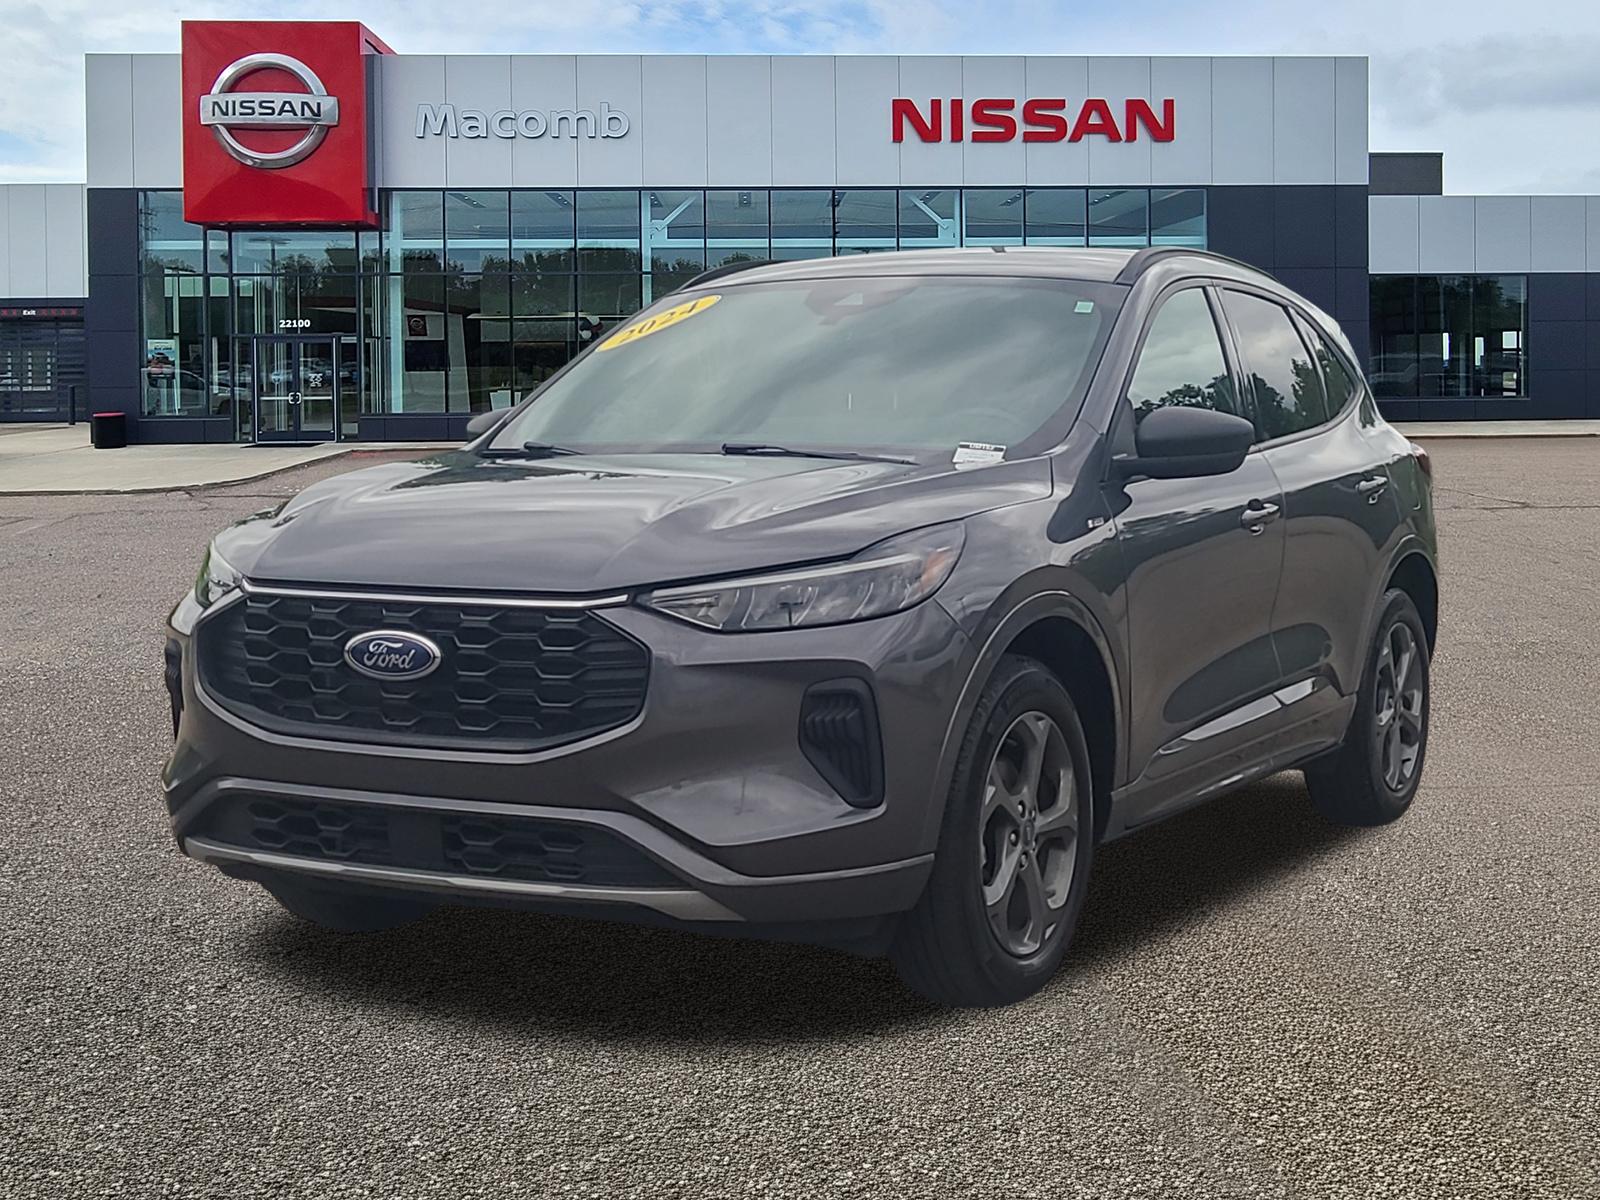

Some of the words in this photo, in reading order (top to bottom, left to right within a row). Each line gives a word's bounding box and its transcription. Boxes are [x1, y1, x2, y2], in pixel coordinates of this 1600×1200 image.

[211, 100, 322, 118] NISSAN
[415, 102, 630, 138] Macomb
[892, 98, 1175, 143] NISSAN
[279, 319, 311, 328] 22100
[618, 300, 700, 343] 2024
[363, 640, 416, 669] Ford
